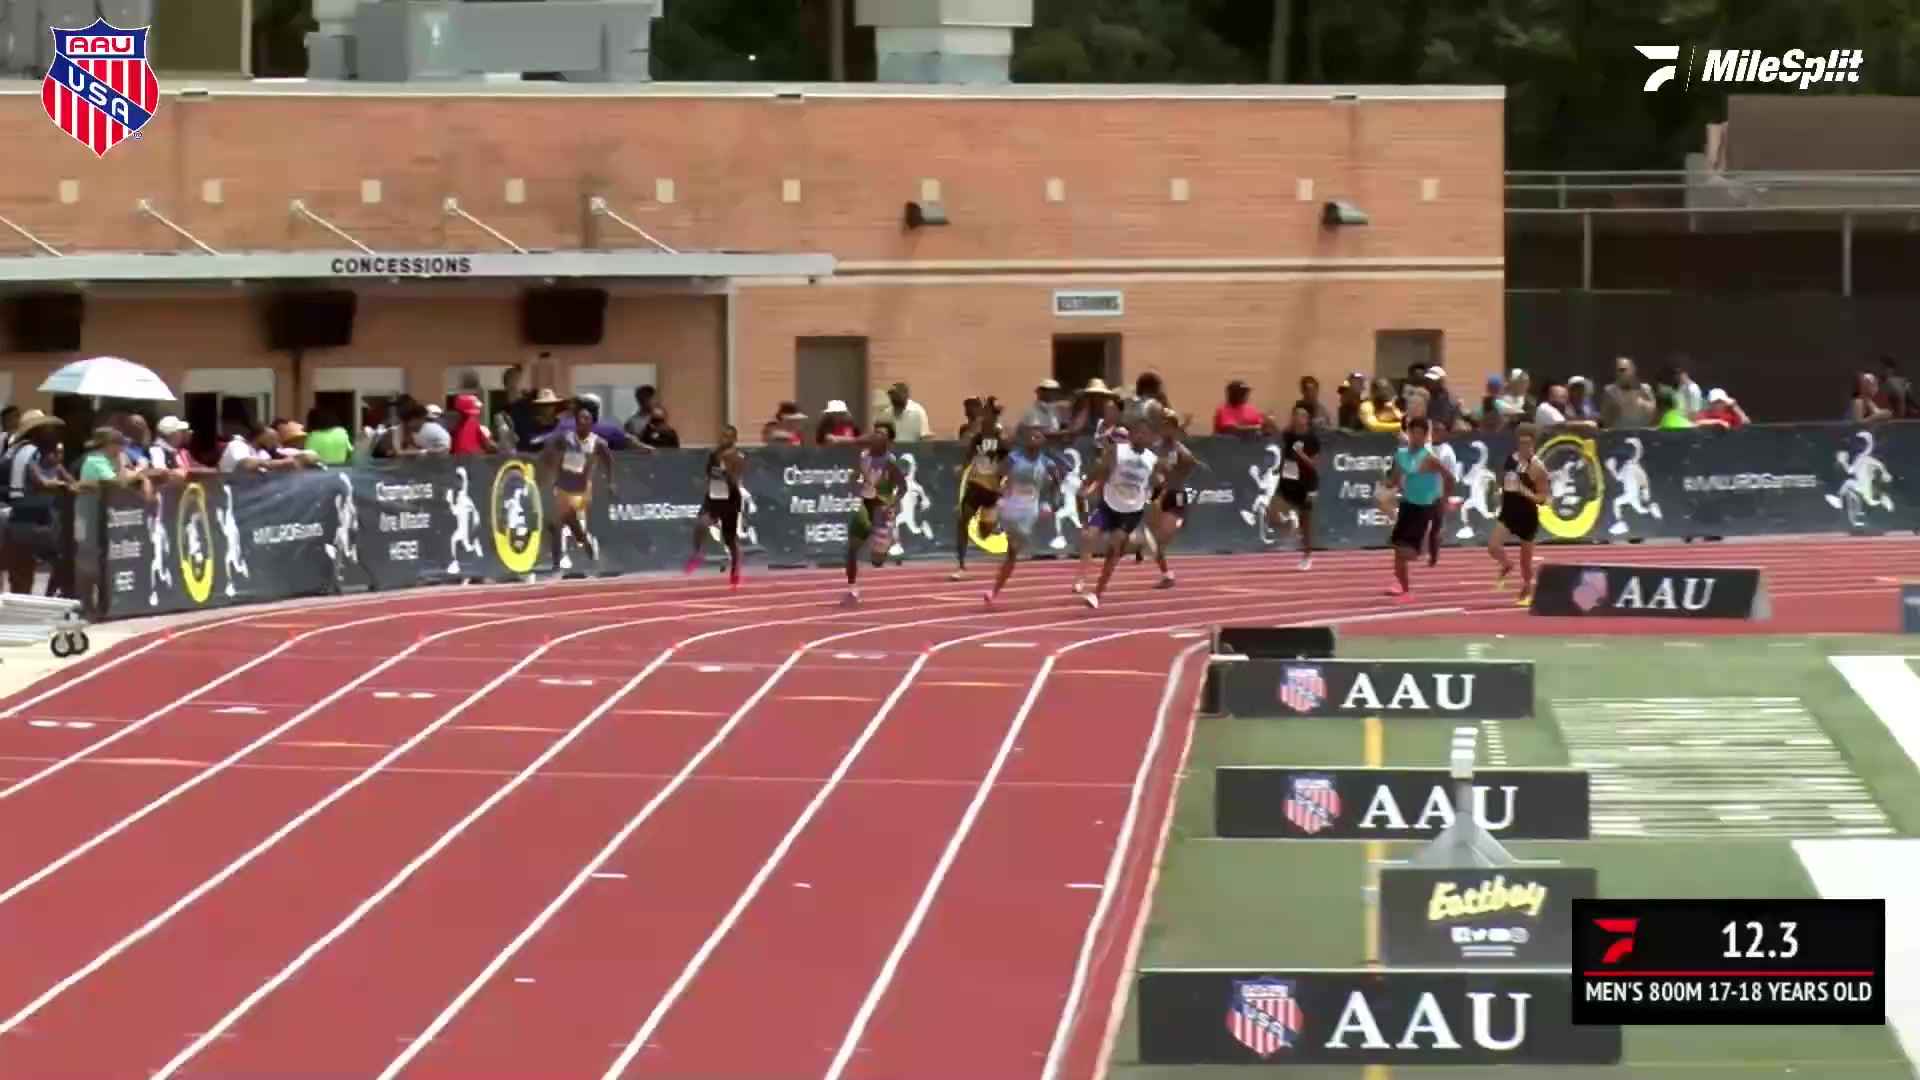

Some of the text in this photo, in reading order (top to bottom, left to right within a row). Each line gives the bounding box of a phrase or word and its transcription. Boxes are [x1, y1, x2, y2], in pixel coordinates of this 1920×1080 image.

[331, 257, 471, 273] CONCESSIONS
[1615, 576, 1716, 610] AAU
[1340, 672, 1476, 710] AAU
[1358, 784, 1519, 830] AAU
[1324, 989, 1533, 1051] AAU
